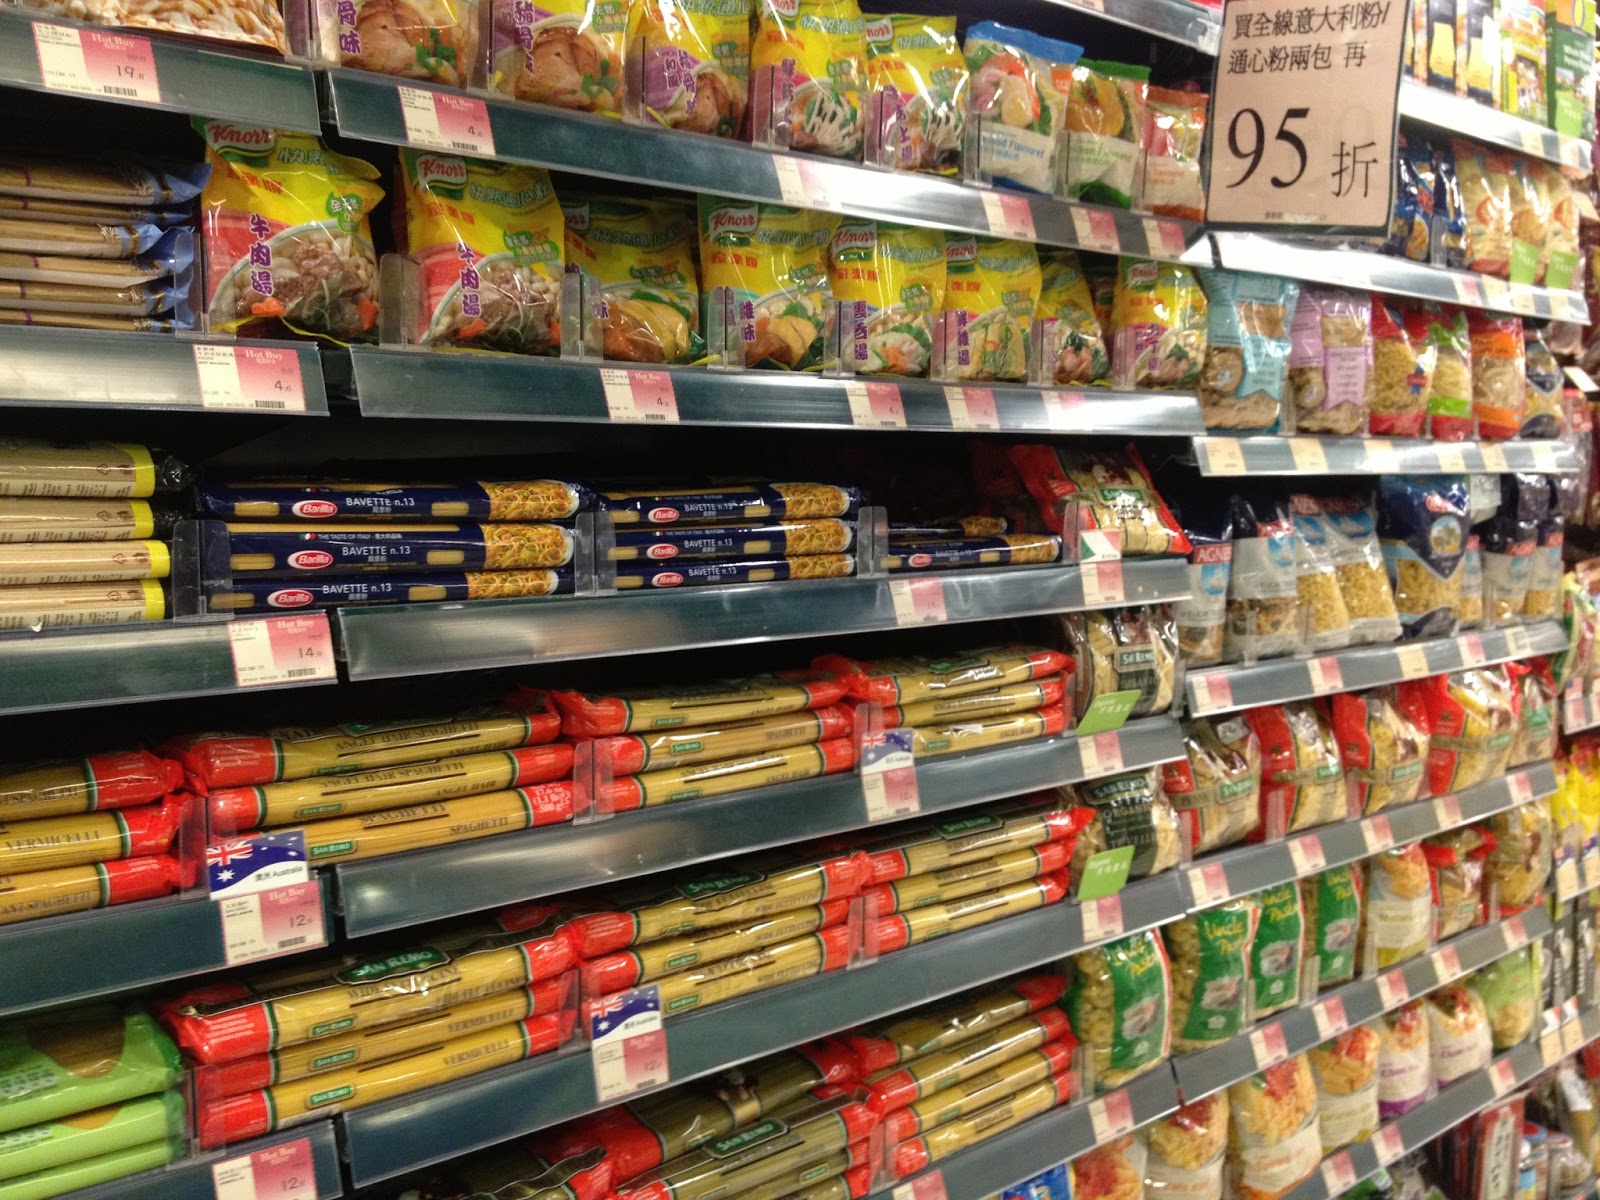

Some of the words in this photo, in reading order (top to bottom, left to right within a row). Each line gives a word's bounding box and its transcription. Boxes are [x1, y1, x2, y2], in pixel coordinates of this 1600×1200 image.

[1232, 2, 1391, 40] 買全線意大利粉/
[91, 32, 113, 44] Hot
[115, 36, 136, 49] Buy
[1227, 43, 1331, 74] 通心粉兩包
[1344, 40, 1367, 68] 再
[208, 124, 272, 145] Knorr
[1226, 108, 1310, 188] 95
[1331, 141, 1378, 198] 折
[420, 157, 466, 178] Knorr
[711, 211, 756, 231] Knorr
[832, 225, 876, 247] Knorr
[250, 212, 274, 296] 牛肉湯
[244, 349, 264, 358] Hot
[264, 350, 284, 361] Buy
[345, 497, 392, 507] BAVETTE
[394, 497, 415, 506] n.13
[683, 503, 716, 512] BAVETTE
[302, 503, 334, 514] Barilla
[655, 511, 677, 519] Barilla
[683, 538, 716, 548] BAVETTE
[717, 538, 733, 546] n.13
[342, 546, 387, 556] BAVETTE
[389, 545, 411, 555] n.13
[652, 547, 676, 556] Barilla
[298, 555, 330, 565] Barilla
[688, 567, 721, 576] BAVETTE
[721, 566, 737, 574] n.13
[658, 575, 681, 584] Barilla
[322, 583, 368, 594] BAVETTE
[370, 583, 392, 592] n.13
[278, 592, 310, 603] Barilla
[277, 621, 294, 629] Hot
[296, 619, 315, 629] Buy
[765, 726, 807, 741] SPAGHETTI
[399, 761, 464, 777] SPAGHETTI
[451, 816, 509, 836] SPAGHETTI
[272, 865, 304, 877] Australia
[269, 890, 287, 900] Hot
[288, 888, 306, 898] Buy
[356, 960, 385, 977] SAN
[388, 951, 433, 968] REMO
